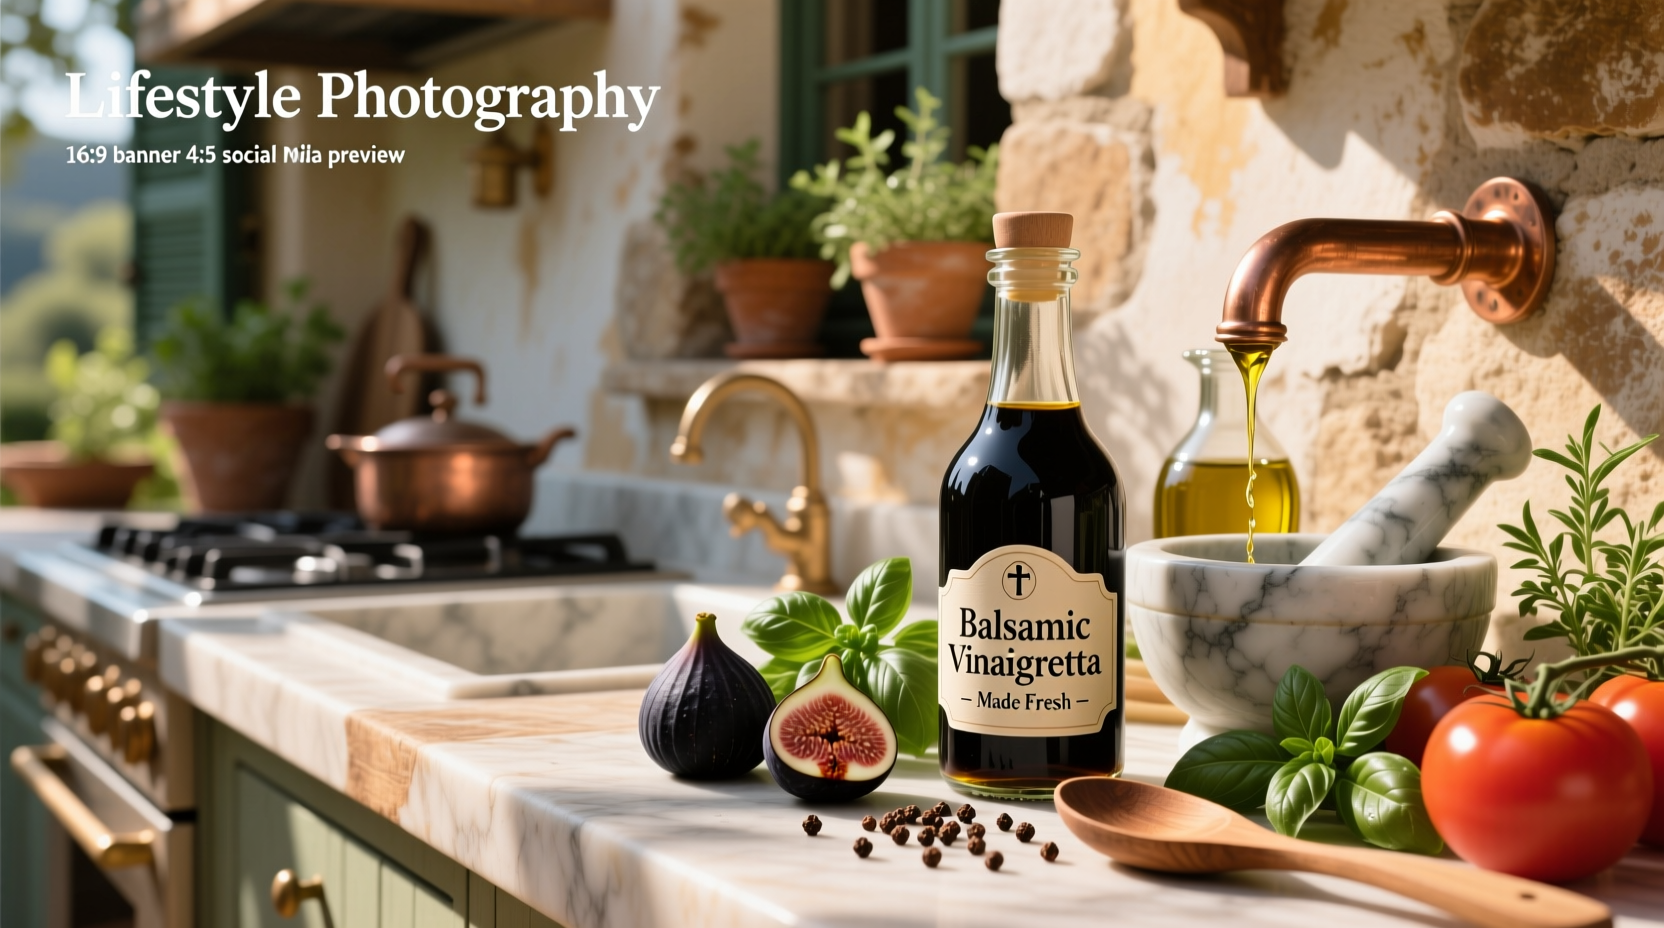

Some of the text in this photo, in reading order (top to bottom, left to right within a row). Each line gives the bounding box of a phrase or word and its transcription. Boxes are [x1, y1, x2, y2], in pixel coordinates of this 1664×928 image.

[959, 607, 1091, 641] Balsamic
[948, 643, 1102, 686] Vinaigretta
[976, 690, 1071, 711] Made Fresh
